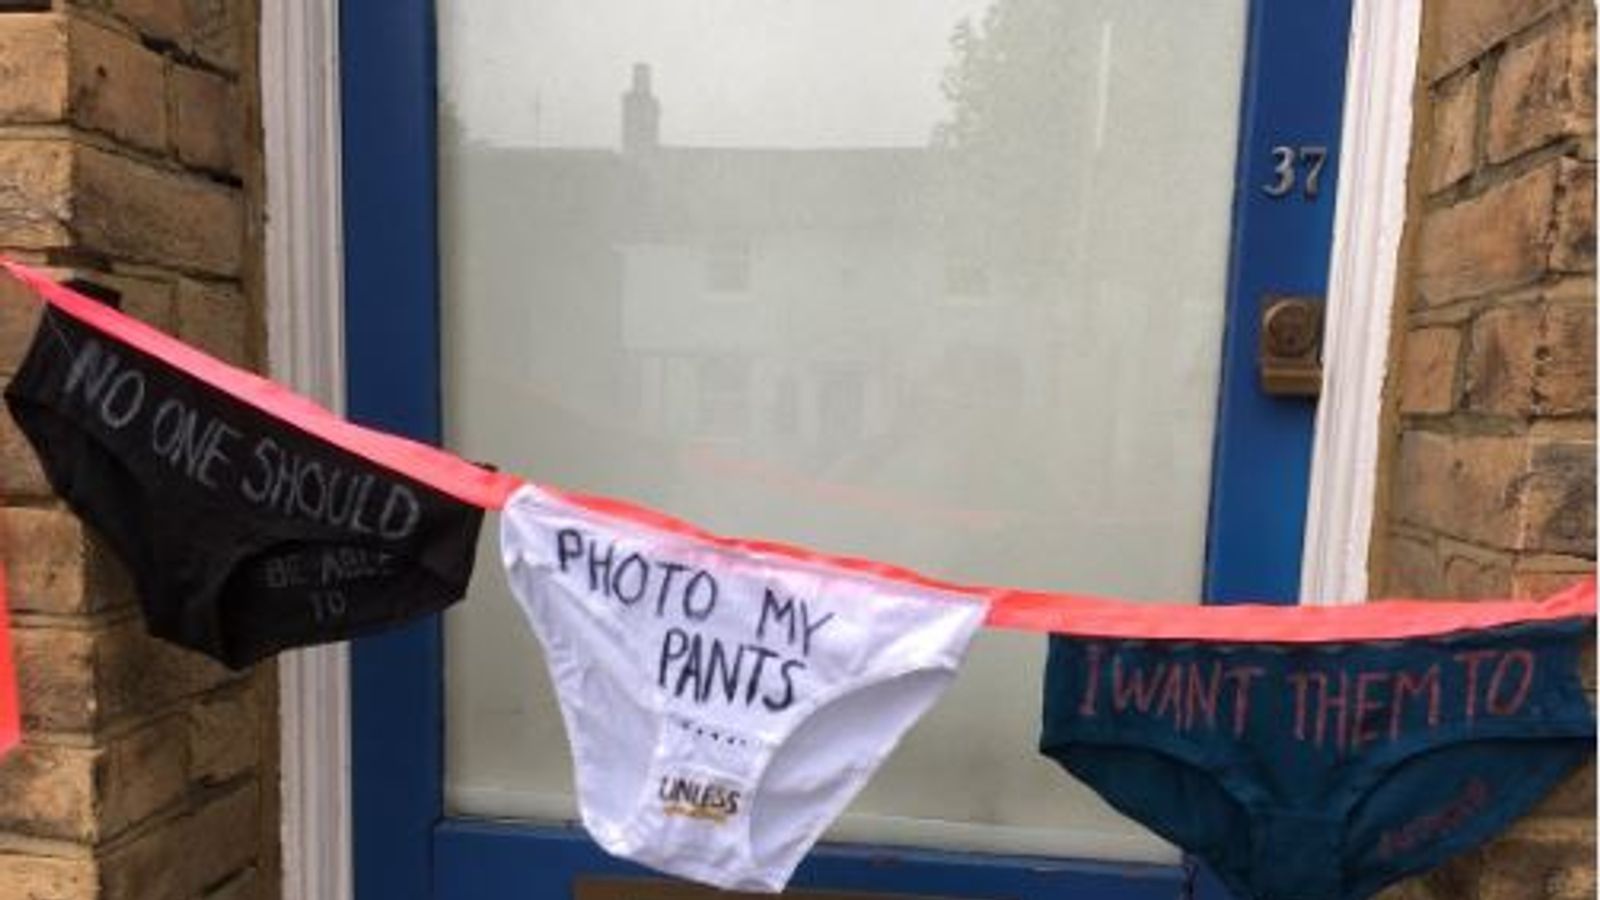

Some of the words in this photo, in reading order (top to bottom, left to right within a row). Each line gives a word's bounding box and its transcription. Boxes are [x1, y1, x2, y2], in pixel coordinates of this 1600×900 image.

[1261, 146, 1327, 195] 37
[65, 340, 145, 427] NO
[152, 402, 242, 487] ONE
[241, 438, 419, 538] SHOULD
[266, 558, 306, 588] BE
[557, 528, 717, 621] PHOTO
[757, 588, 833, 655] MY
[311, 593, 348, 620] TO
[658, 628, 804, 711] PANTS
[1079, 644, 1107, 716] I
[1113, 655, 1263, 737] WANT
[1286, 661, 1440, 754] THEM
[1453, 650, 1534, 722] TO
[659, 776, 741, 814] UNLESS
